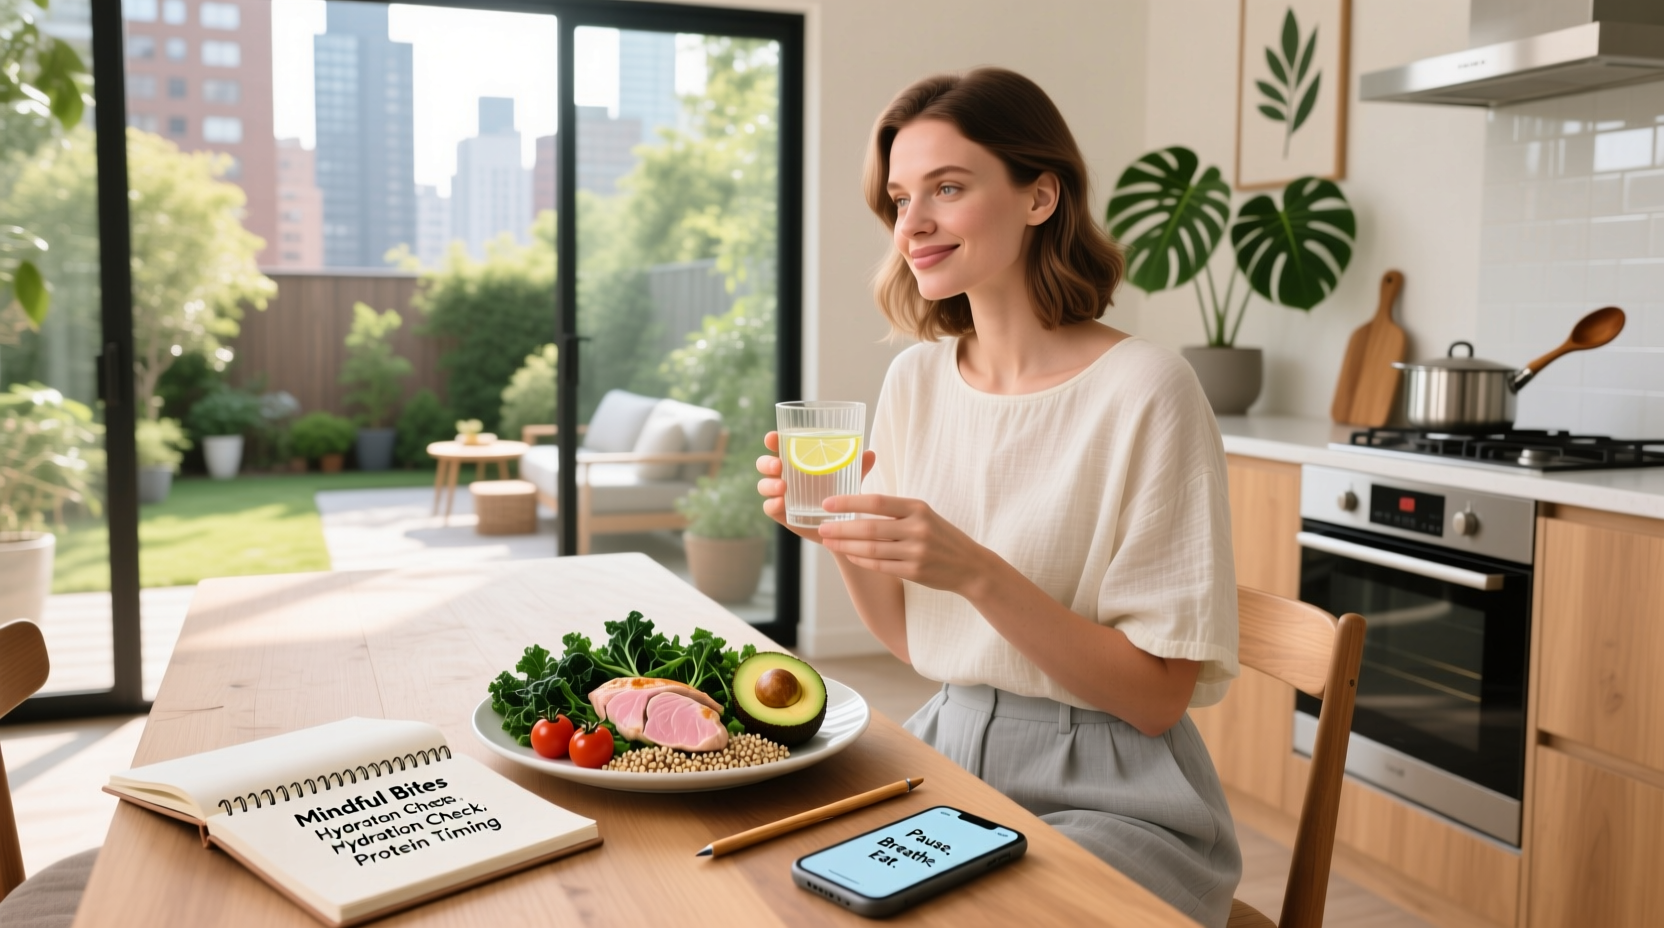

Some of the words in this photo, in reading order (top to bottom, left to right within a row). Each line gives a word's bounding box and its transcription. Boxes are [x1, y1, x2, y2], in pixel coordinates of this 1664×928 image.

[294, 790, 388, 828] Mindful
[389, 778, 448, 801] Bites
[354, 838, 431, 867] Protein
[431, 817, 502, 842] Timing
[905, 829, 951, 856] Pause.
